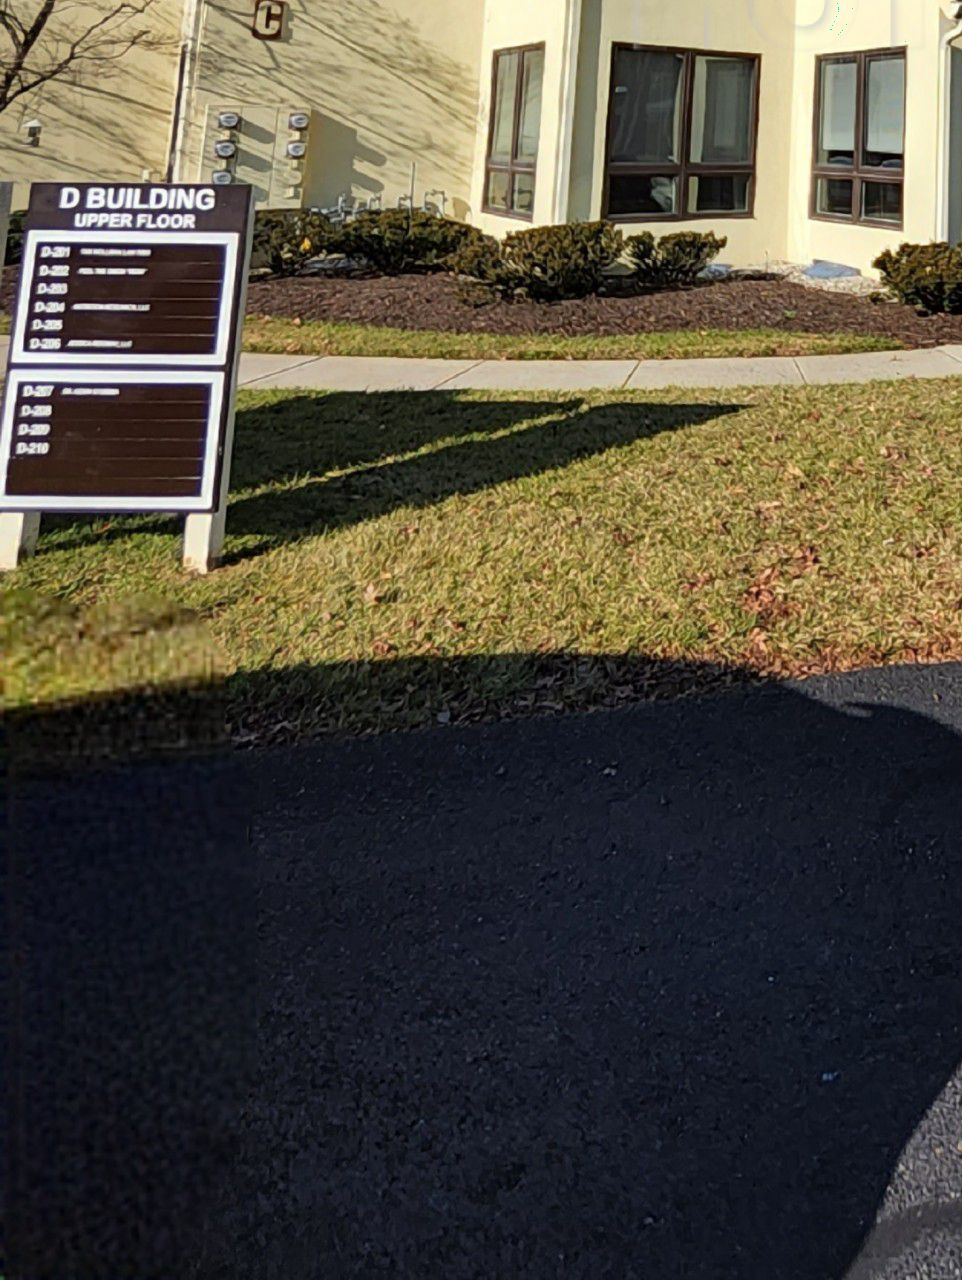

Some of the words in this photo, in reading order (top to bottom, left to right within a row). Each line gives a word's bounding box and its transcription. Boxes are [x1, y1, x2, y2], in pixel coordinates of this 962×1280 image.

[256, 0, 281, 35] C
[59, 186, 80, 209] D
[86, 187, 216, 211] BUILDING
[74, 213, 133, 228] UPPER
[135, 213, 196, 229] FLOOR
[40, 246, 71, 258] D-201
[15, 442, 50, 455] D-210
